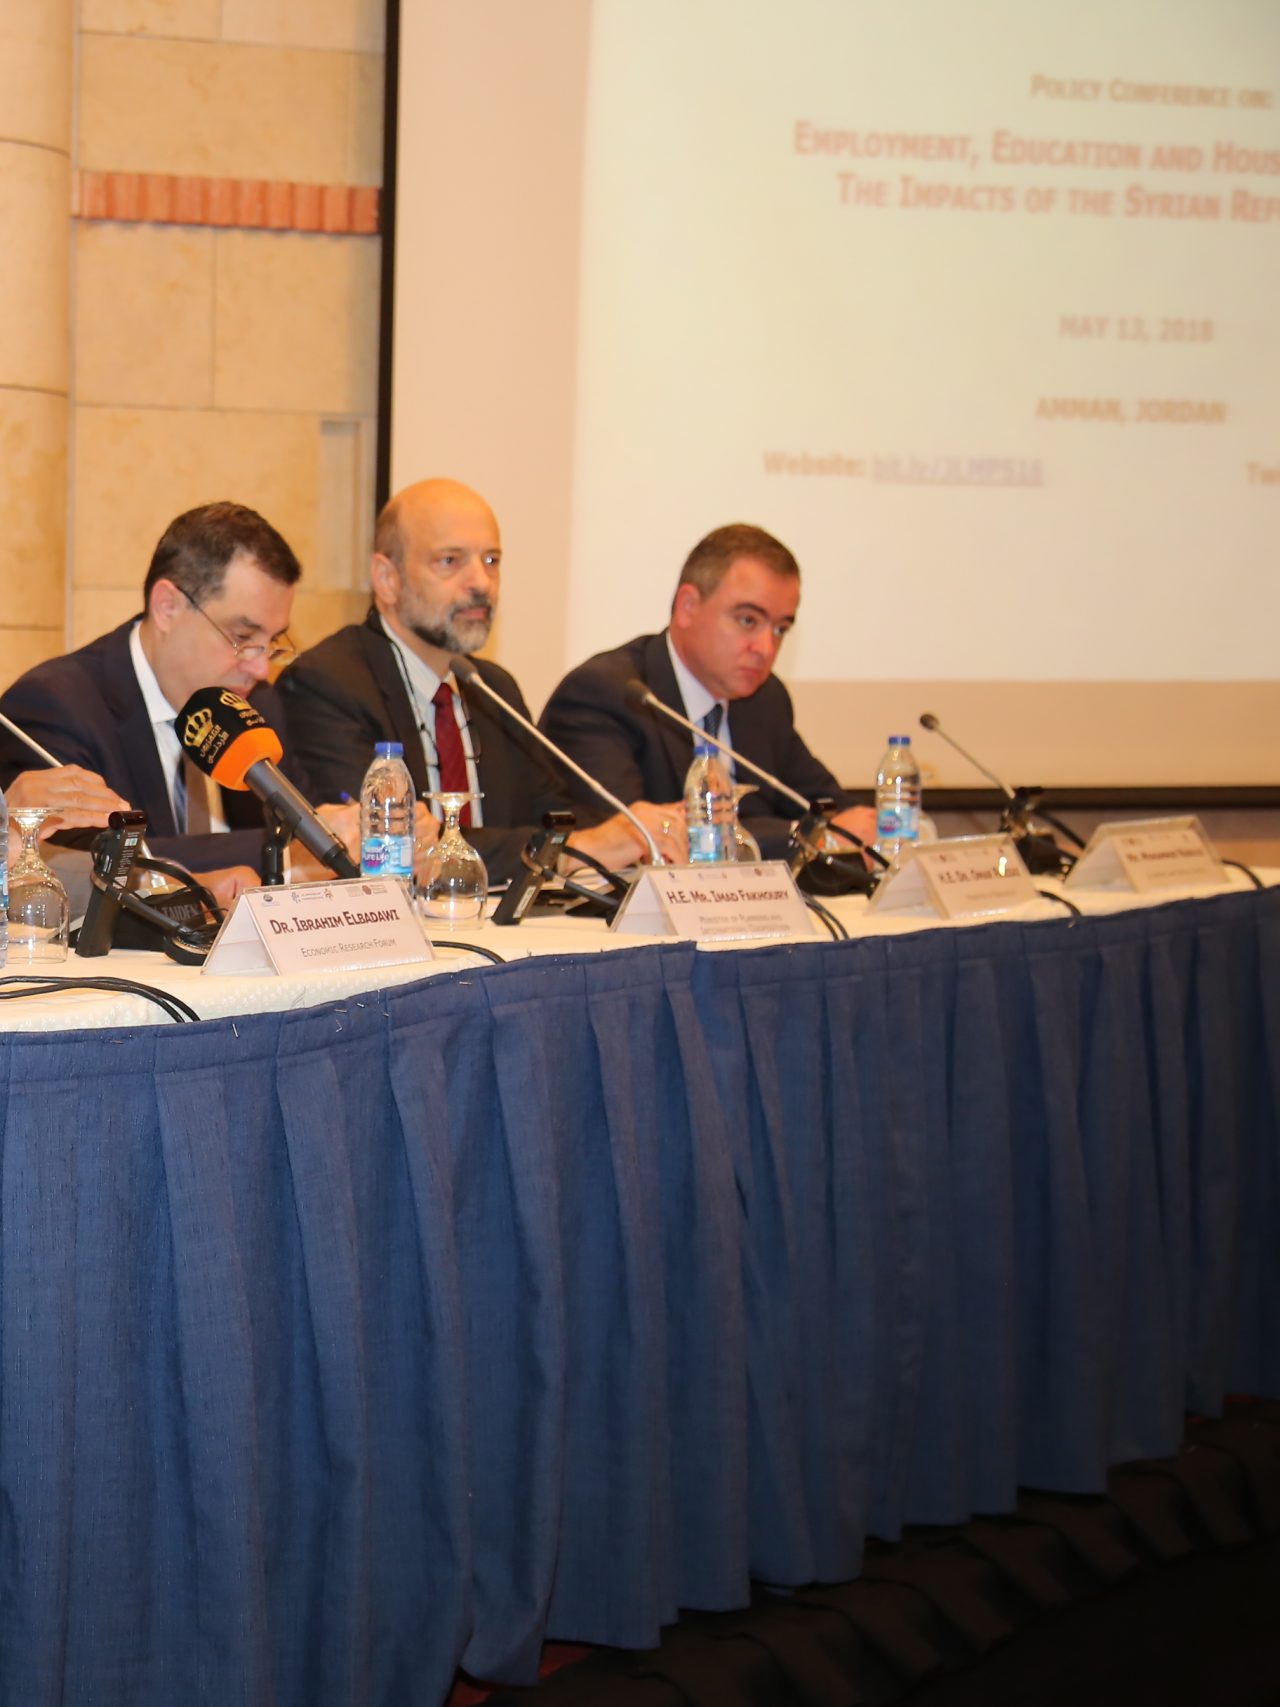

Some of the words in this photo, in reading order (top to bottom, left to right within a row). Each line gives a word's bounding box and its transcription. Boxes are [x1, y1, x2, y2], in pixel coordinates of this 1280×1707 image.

[1030, 74, 1102, 101] POLICY
[1108, 79, 1229, 108] CONFERENCE
[793, 120, 980, 171] EMPLOYMENT,
[991, 129, 1142, 170] EDUCATION
[1149, 145, 1203, 173] AND
[836, 172, 888, 208] THE
[898, 174, 1016, 213] IMPACTS
[1023, 187, 1057, 214] OF
[1067, 189, 1114, 217] THE
[1123, 184, 1221, 221] SYRIAN
[1058, 316, 1109, 339] MAY
[1034, 397, 1126, 427] AMMAN,
[1134, 398, 1228, 425] JORDAN
[666, 890, 691, 904] H.E.
[690, 890, 712, 903] MR.
[710, 890, 739, 903] IMAD
[270, 919, 294, 935] DR.
[292, 915, 345, 932] IBRAHIM
[342, 909, 400, 926] ELBADAWI
[300, 945, 339, 958] ECONOMIC
[338, 941, 373, 953] RESEARCH
[373, 937, 398, 948] FORUM
